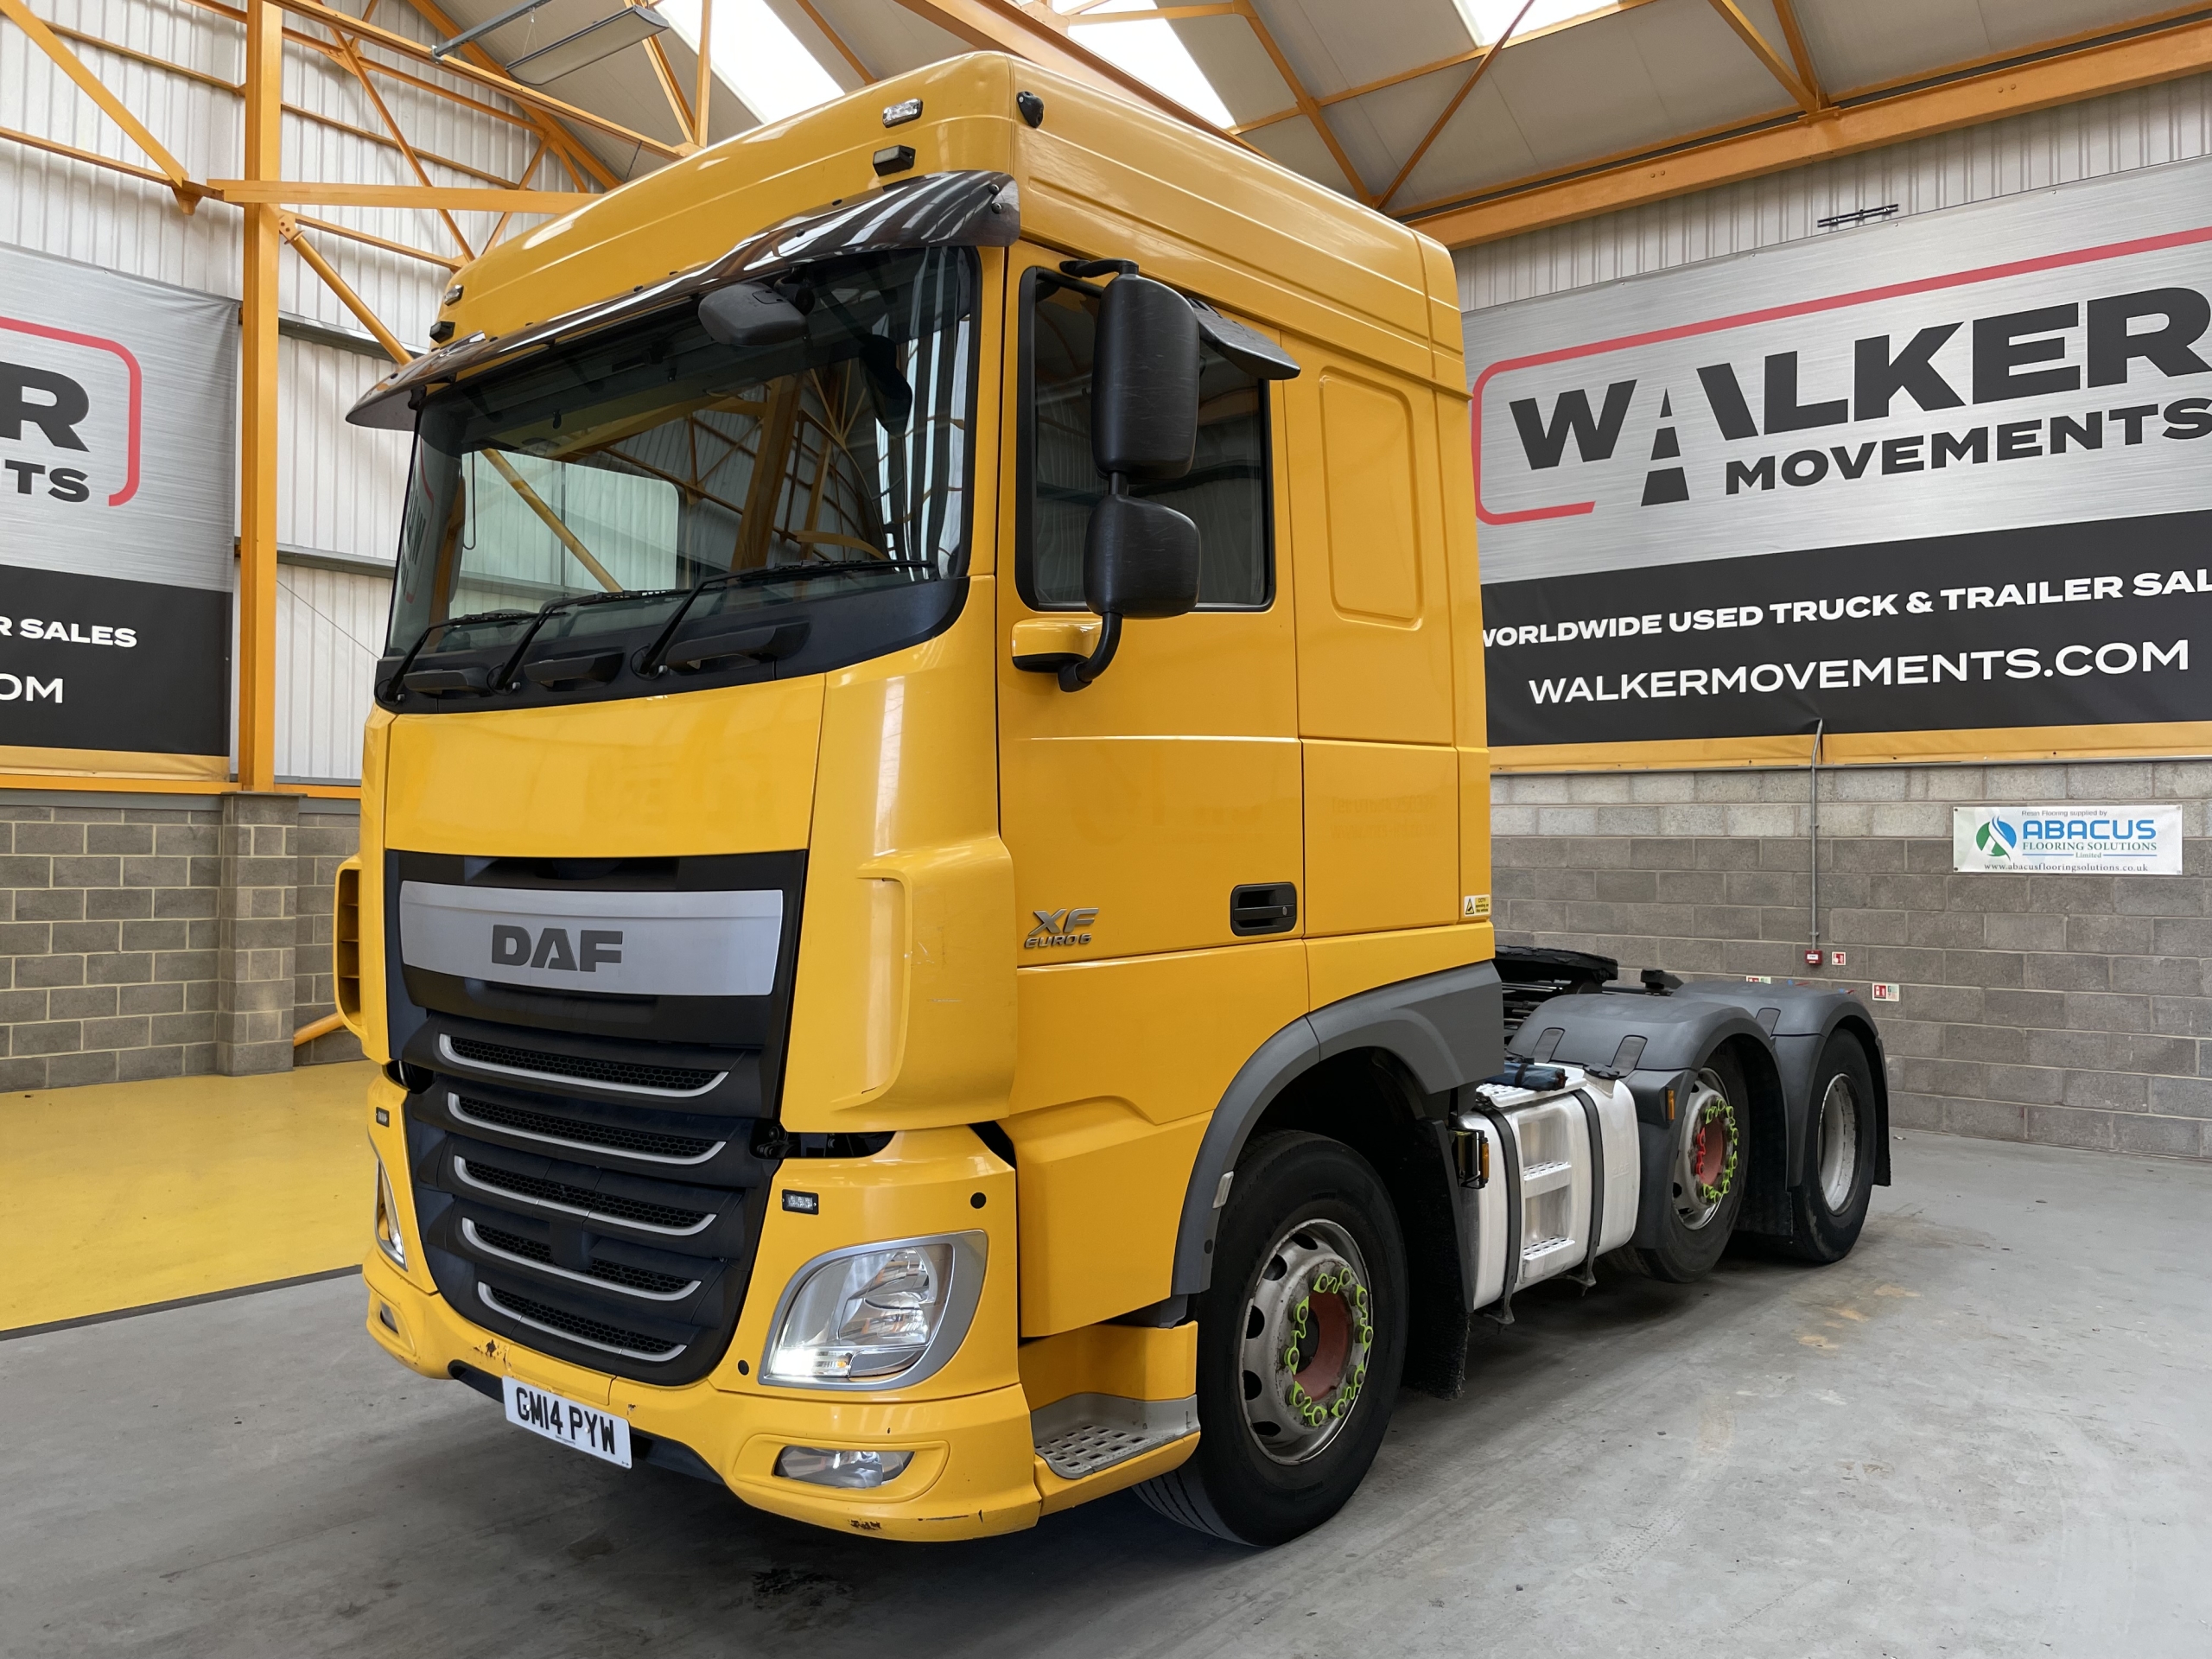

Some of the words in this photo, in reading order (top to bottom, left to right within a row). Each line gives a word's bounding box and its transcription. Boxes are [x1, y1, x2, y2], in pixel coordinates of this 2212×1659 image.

[1509, 287, 2212, 506] WALKER
[1726, 397, 2212, 495] MOVEMENTS
[4, 460, 90, 503] TS
[1669, 606, 1764, 632] USED
[1770, 594, 1899, 624] TRUCK
[1906, 591, 1935, 614] &
[1941, 576, 2124, 611] TRAILER
[2133, 569, 2212, 596] SAL
[19, 618, 137, 648] SALES
[0, 673, 64, 703] OM
[1528, 639, 2189, 704] WALKERMOVEMENTS.COM
[2023, 819, 2157, 840] ABACUS
[2023, 842, 2084, 851] FLOORING
[2087, 842, 2158, 851] SOLUTIONS
[1984, 862, 2149, 873] www.abacusflooringsolutions.co.uk
[1028, 907, 1099, 937] XF
[492, 925, 624, 973] DAF
[516, 1386, 563, 1435] GM14
[569, 1405, 616, 1455] PYW
